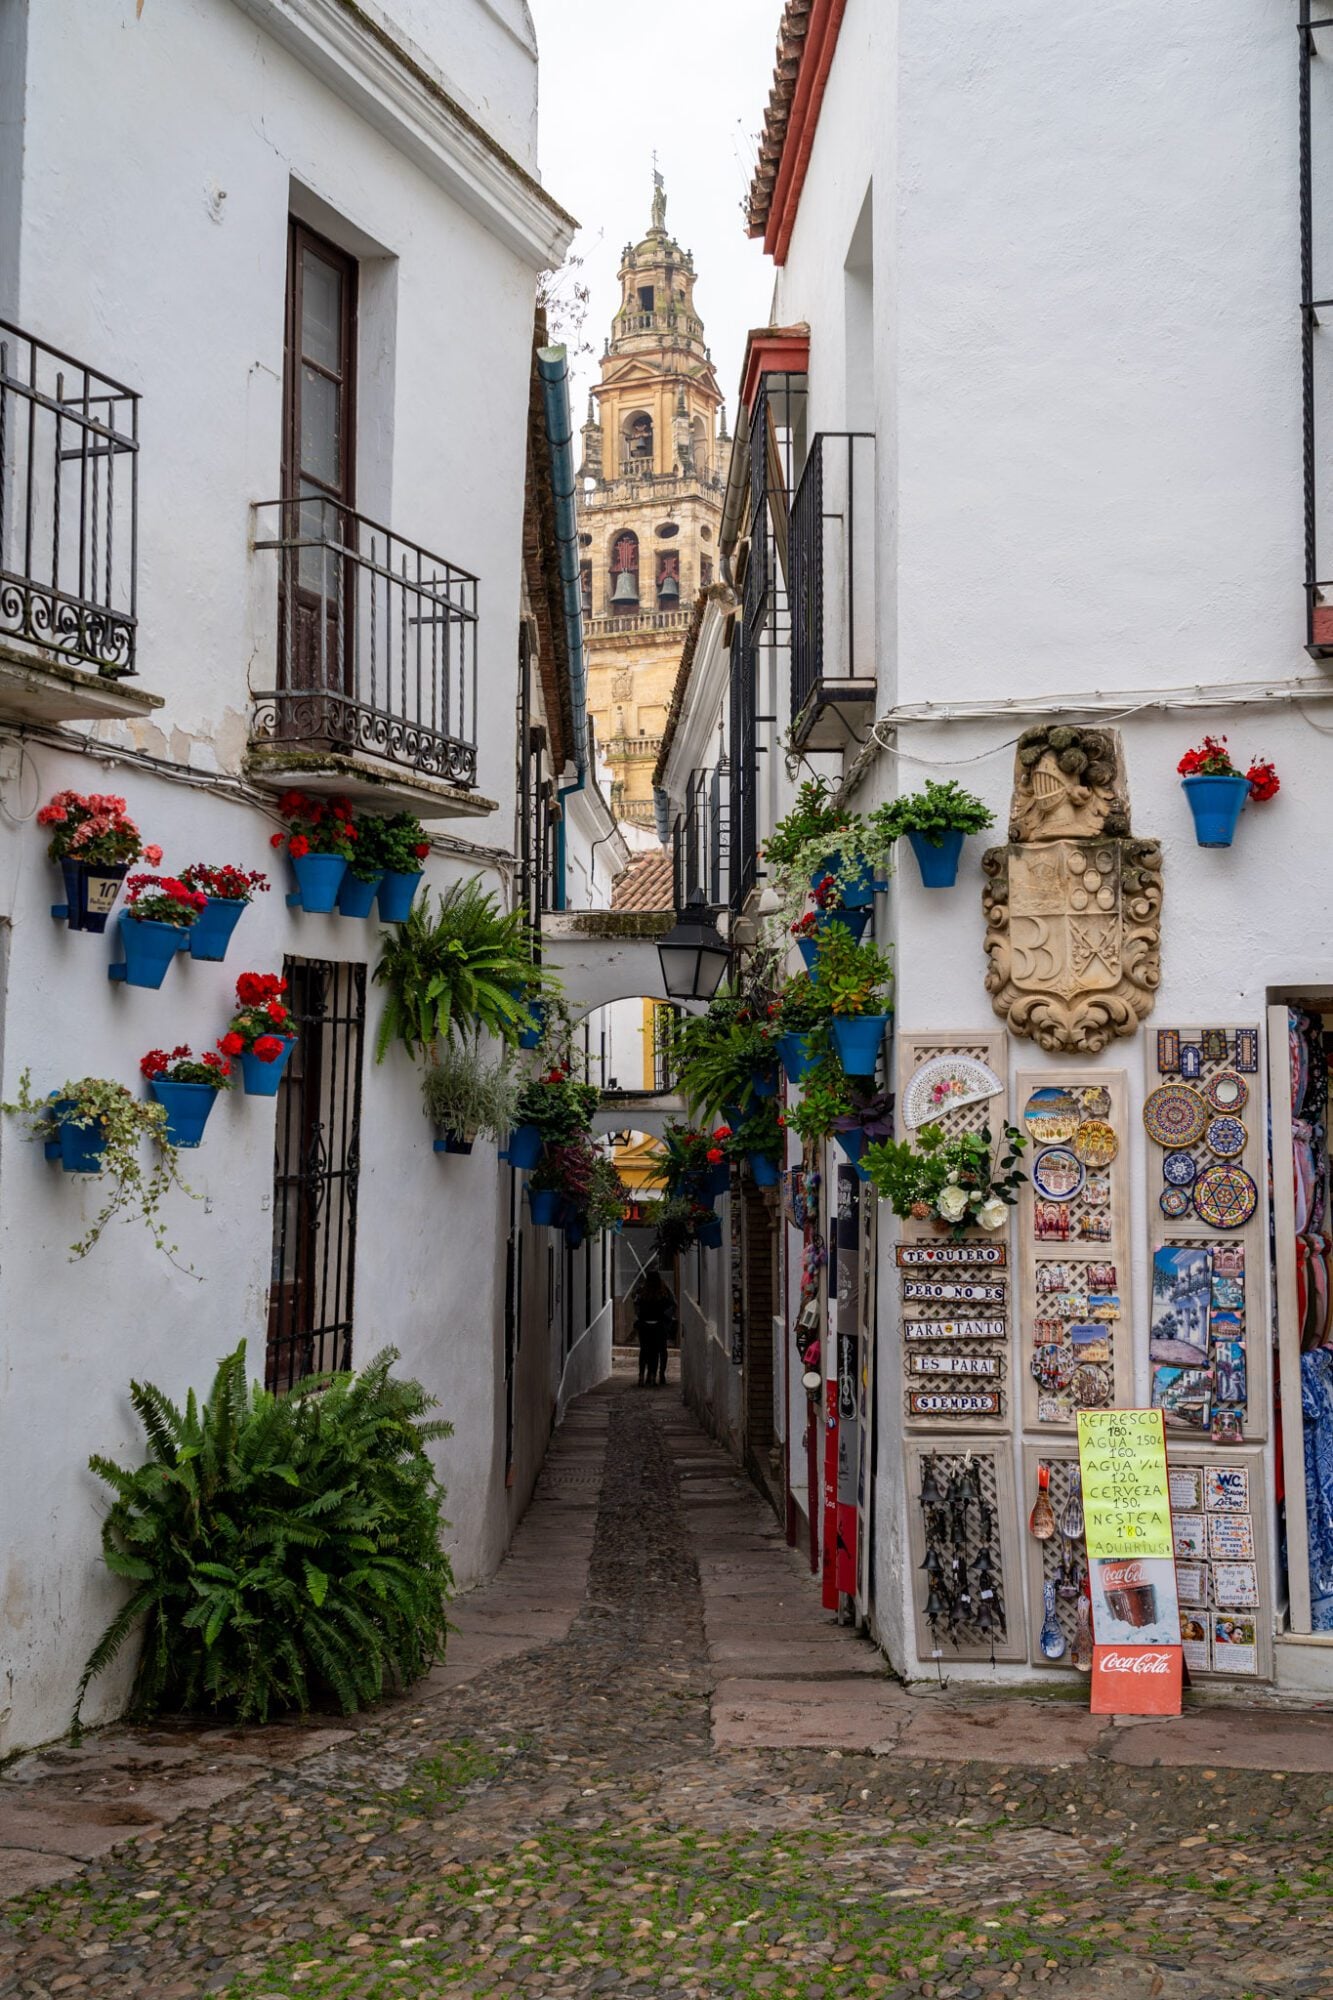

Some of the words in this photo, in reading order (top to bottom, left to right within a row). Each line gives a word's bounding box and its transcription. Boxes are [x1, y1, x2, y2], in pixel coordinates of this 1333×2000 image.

[907, 1252, 924, 1262] TE
[936, 1250, 996, 1260] QUIERO
[906, 1286, 942, 1296] PERO
[954, 1288, 973, 1298] NO
[985, 1289, 1003, 1298] ES
[906, 1325, 944, 1336] PARA
[954, 1322, 1003, 1334] TANTO
[921, 1358, 940, 1370] ES
[951, 1360, 988, 1372] PARA
[920, 1398, 988, 1408] SIEMPRE
[1080, 1412, 1159, 1428] REFRESCO
[1085, 1436, 1127, 1448] AGUA
[1086, 1460, 1132, 1472] AGUA
[1090, 1485, 1162, 1498] CERVEZA
[1094, 1512, 1162, 1525] NESTEA
[1100, 1652, 1172, 1674] Coca-Cola
